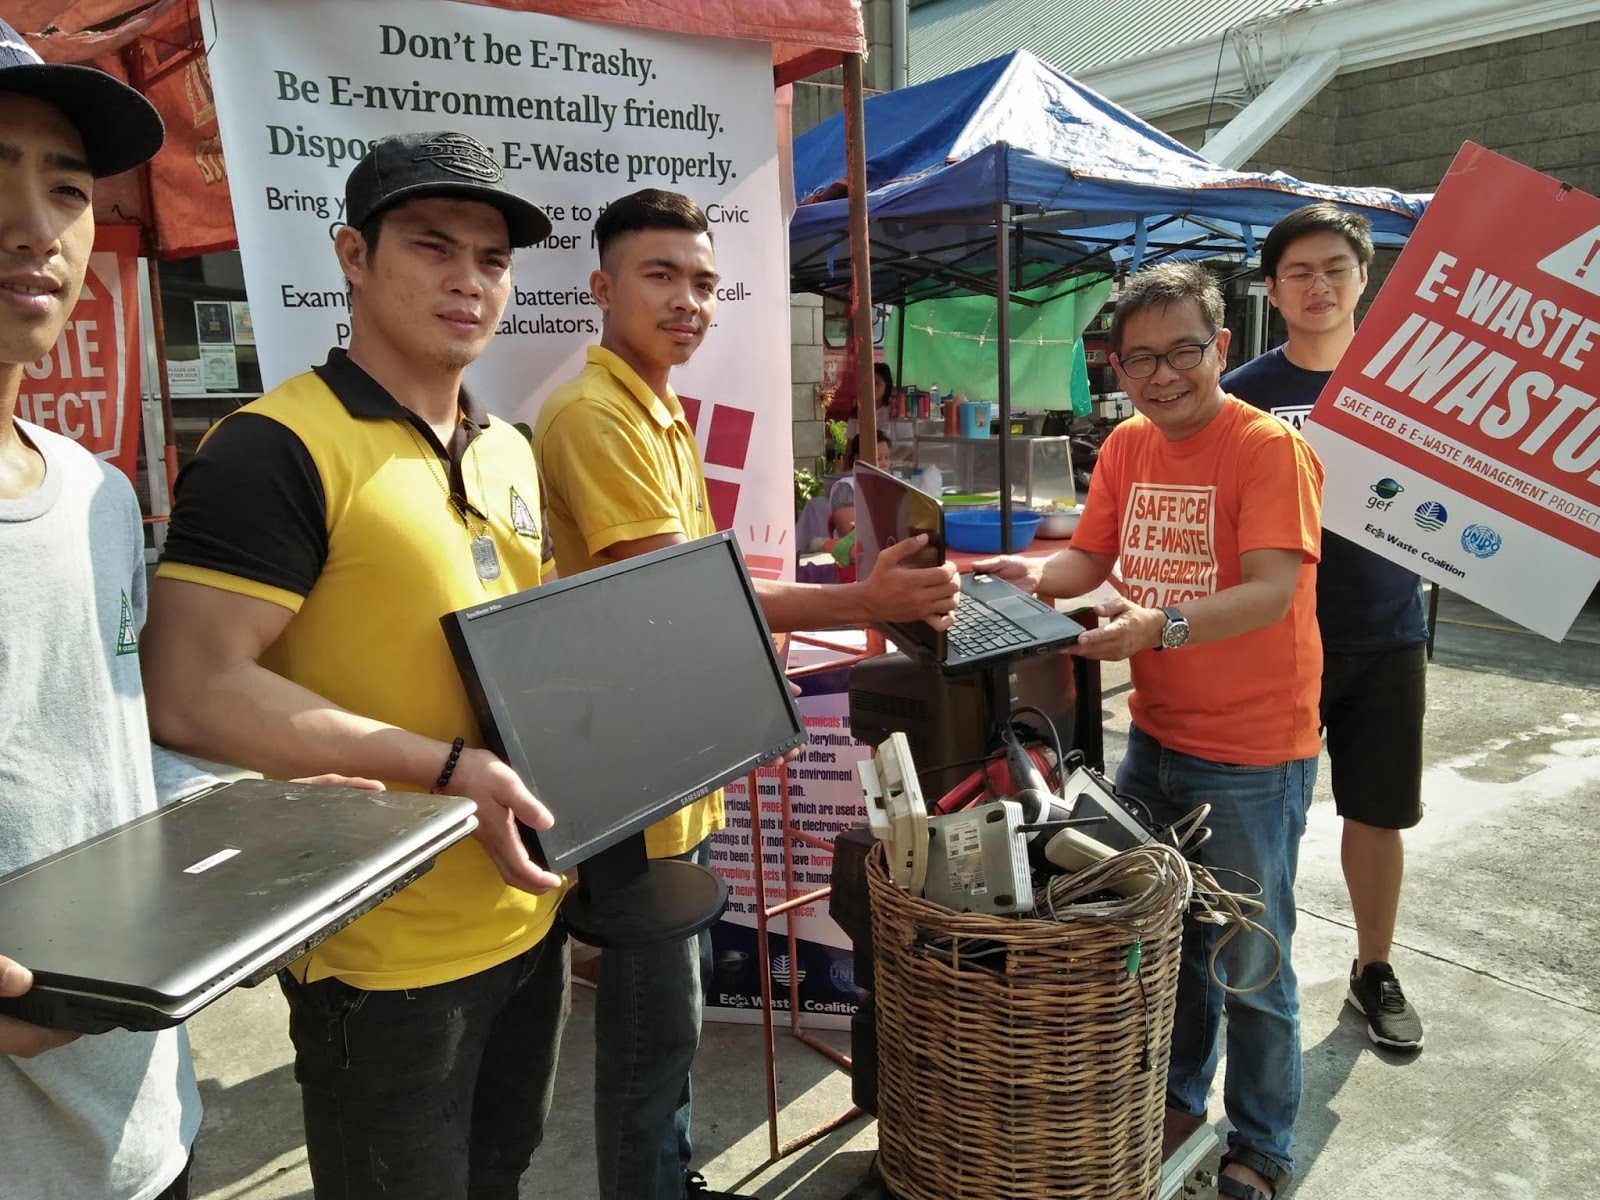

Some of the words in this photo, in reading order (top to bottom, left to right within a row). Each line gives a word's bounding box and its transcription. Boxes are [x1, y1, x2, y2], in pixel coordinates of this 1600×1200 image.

[379, 24, 475, 62] Don't
[483, 33, 521, 66] be
[529, 39, 657, 86] E-Trashy.
[274, 70, 319, 104] Be
[328, 76, 617, 132] E-nvironmentally
[623, 98, 724, 139] friendly.
[501, 141, 619, 174] E-Waste
[627, 152, 737, 185] properly.
[266, 187, 330, 219] Bring
[572, 205, 592, 222] to
[706, 203, 749, 223] Civic
[717, 282, 751, 301] cell-
[1415, 250, 1600, 372] E-WASTE
[1340, 394, 1373, 418] SAFE
[1373, 412, 1397, 430] PCB
[1397, 423, 1408, 436] &
[1408, 428, 1463, 462] E-WASTE
[1463, 454, 1549, 502] MANAGEMENT
[1134, 494, 1177, 522] SAFE
[1178, 497, 1207, 524] PCB
[1365, 496, 1394, 512] gef
[1127, 524, 1141, 550] &
[1144, 525, 1209, 556] E-WASTE
[1462, 526, 1501, 553] UNIDO
[1122, 554, 1212, 586] MANAGEMENT
[1386, 532, 1419, 556] Waste
[1421, 551, 1467, 579] Coalition
[808, 750, 837, 763] ethers
[799, 767, 852, 782] environment
[680, 786, 709, 806] SAMSUNG
[791, 802, 817, 815] which
[818, 804, 834, 815] are
[835, 804, 856, 816] used
[741, 834, 750, 846] of
[729, 850, 750, 863] been
